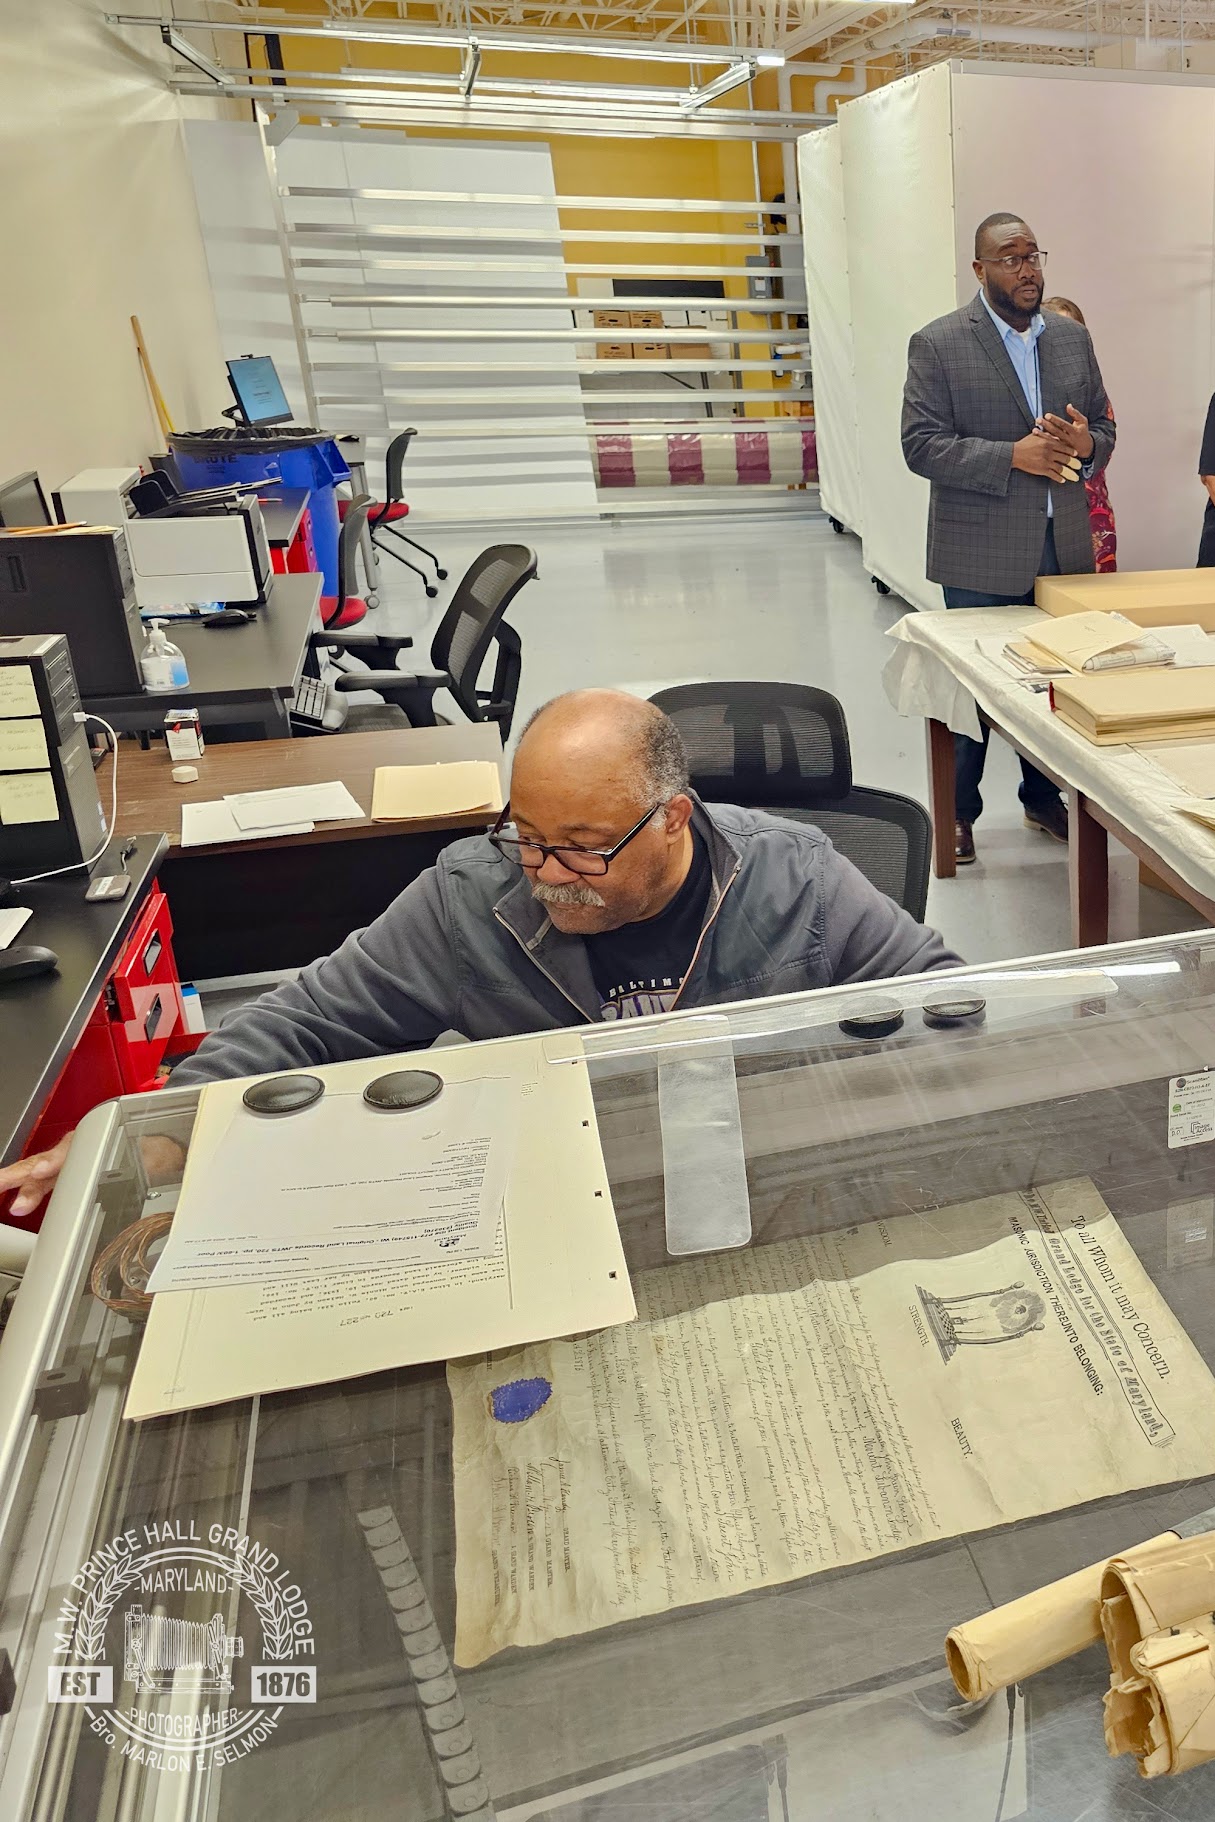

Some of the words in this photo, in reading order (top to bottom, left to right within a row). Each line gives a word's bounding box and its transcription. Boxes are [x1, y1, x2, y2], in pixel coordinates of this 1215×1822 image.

[1069, 1213, 1088, 1231] To
[1077, 1228, 1096, 1246] all
[1087, 1243, 1117, 1283] Whom
[1079, 1293, 1097, 1312] for
[1108, 1280, 1124, 1295] it
[1007, 1214, 1029, 1246] MASONIC
[1048, 1293, 1079, 1344] THEREUNTO
[1071, 1343, 1107, 1396] BELONGING:
[1089, 1309, 1107, 1329] the
[1112, 1292, 1140, 1325] may
[906, 1303, 931, 1347] STRENGTH.
[1099, 1326, 1124, 1358] State
[1131, 1319, 1174, 1380] Concern.
[1116, 1357, 1134, 1376] of
[1119, 1373, 1165, 1438] Maryland,
[949, 1417, 974, 1459] BEAUTY.
